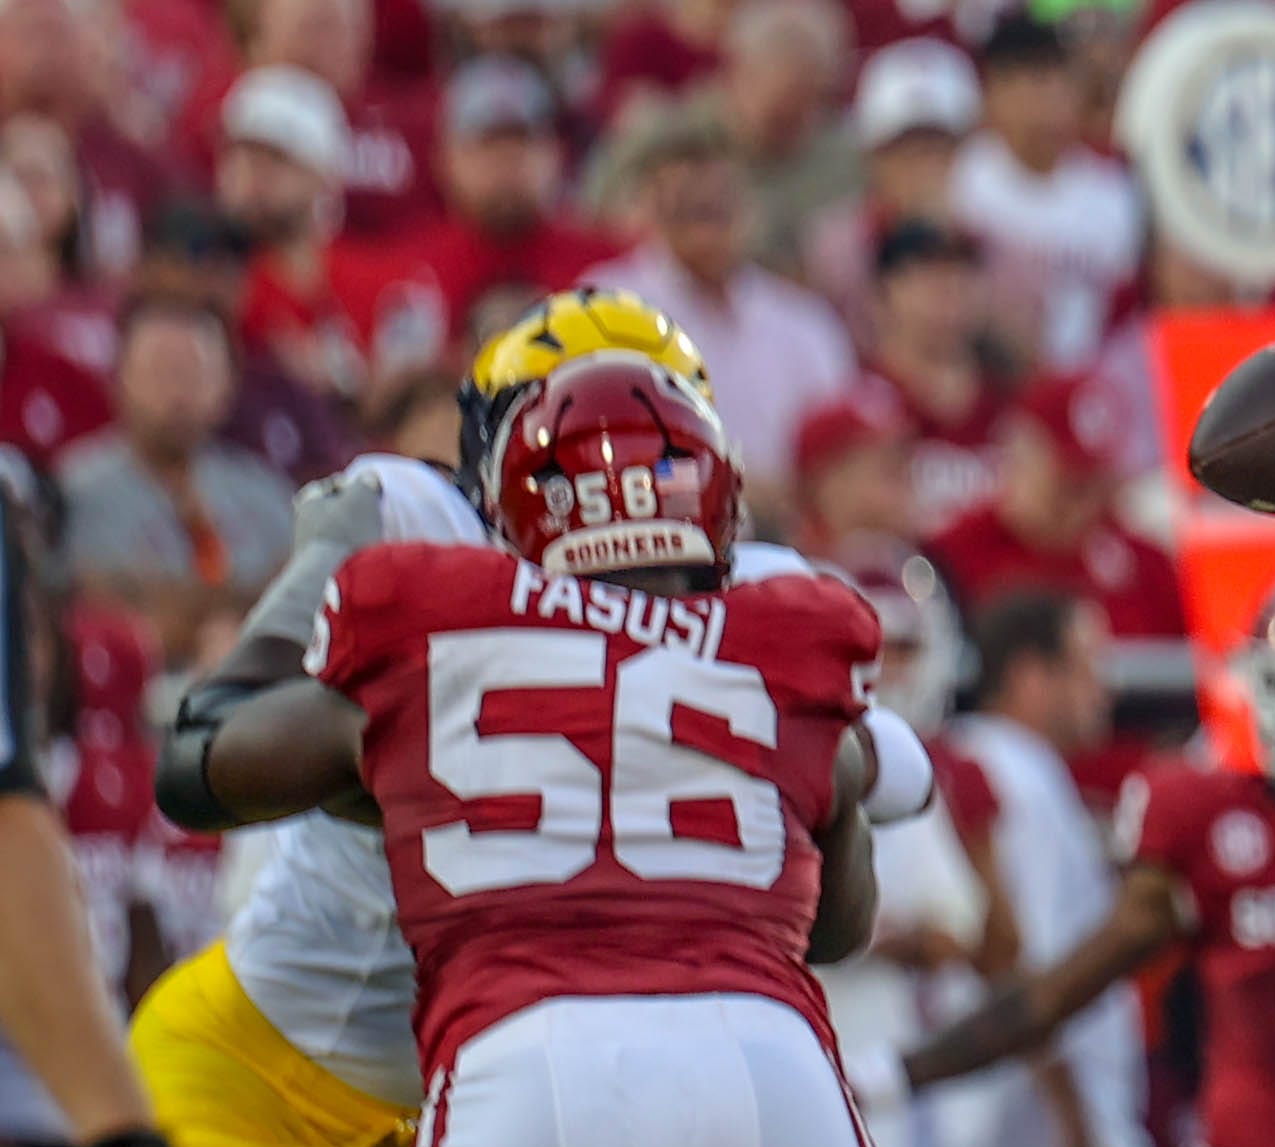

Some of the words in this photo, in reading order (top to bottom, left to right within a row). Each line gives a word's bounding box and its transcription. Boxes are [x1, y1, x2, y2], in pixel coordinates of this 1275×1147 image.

[575, 465, 658, 526] 56
[564, 531, 683, 565] SOONERS
[510, 559, 728, 664] FASUSI
[421, 626, 787, 898] 56
